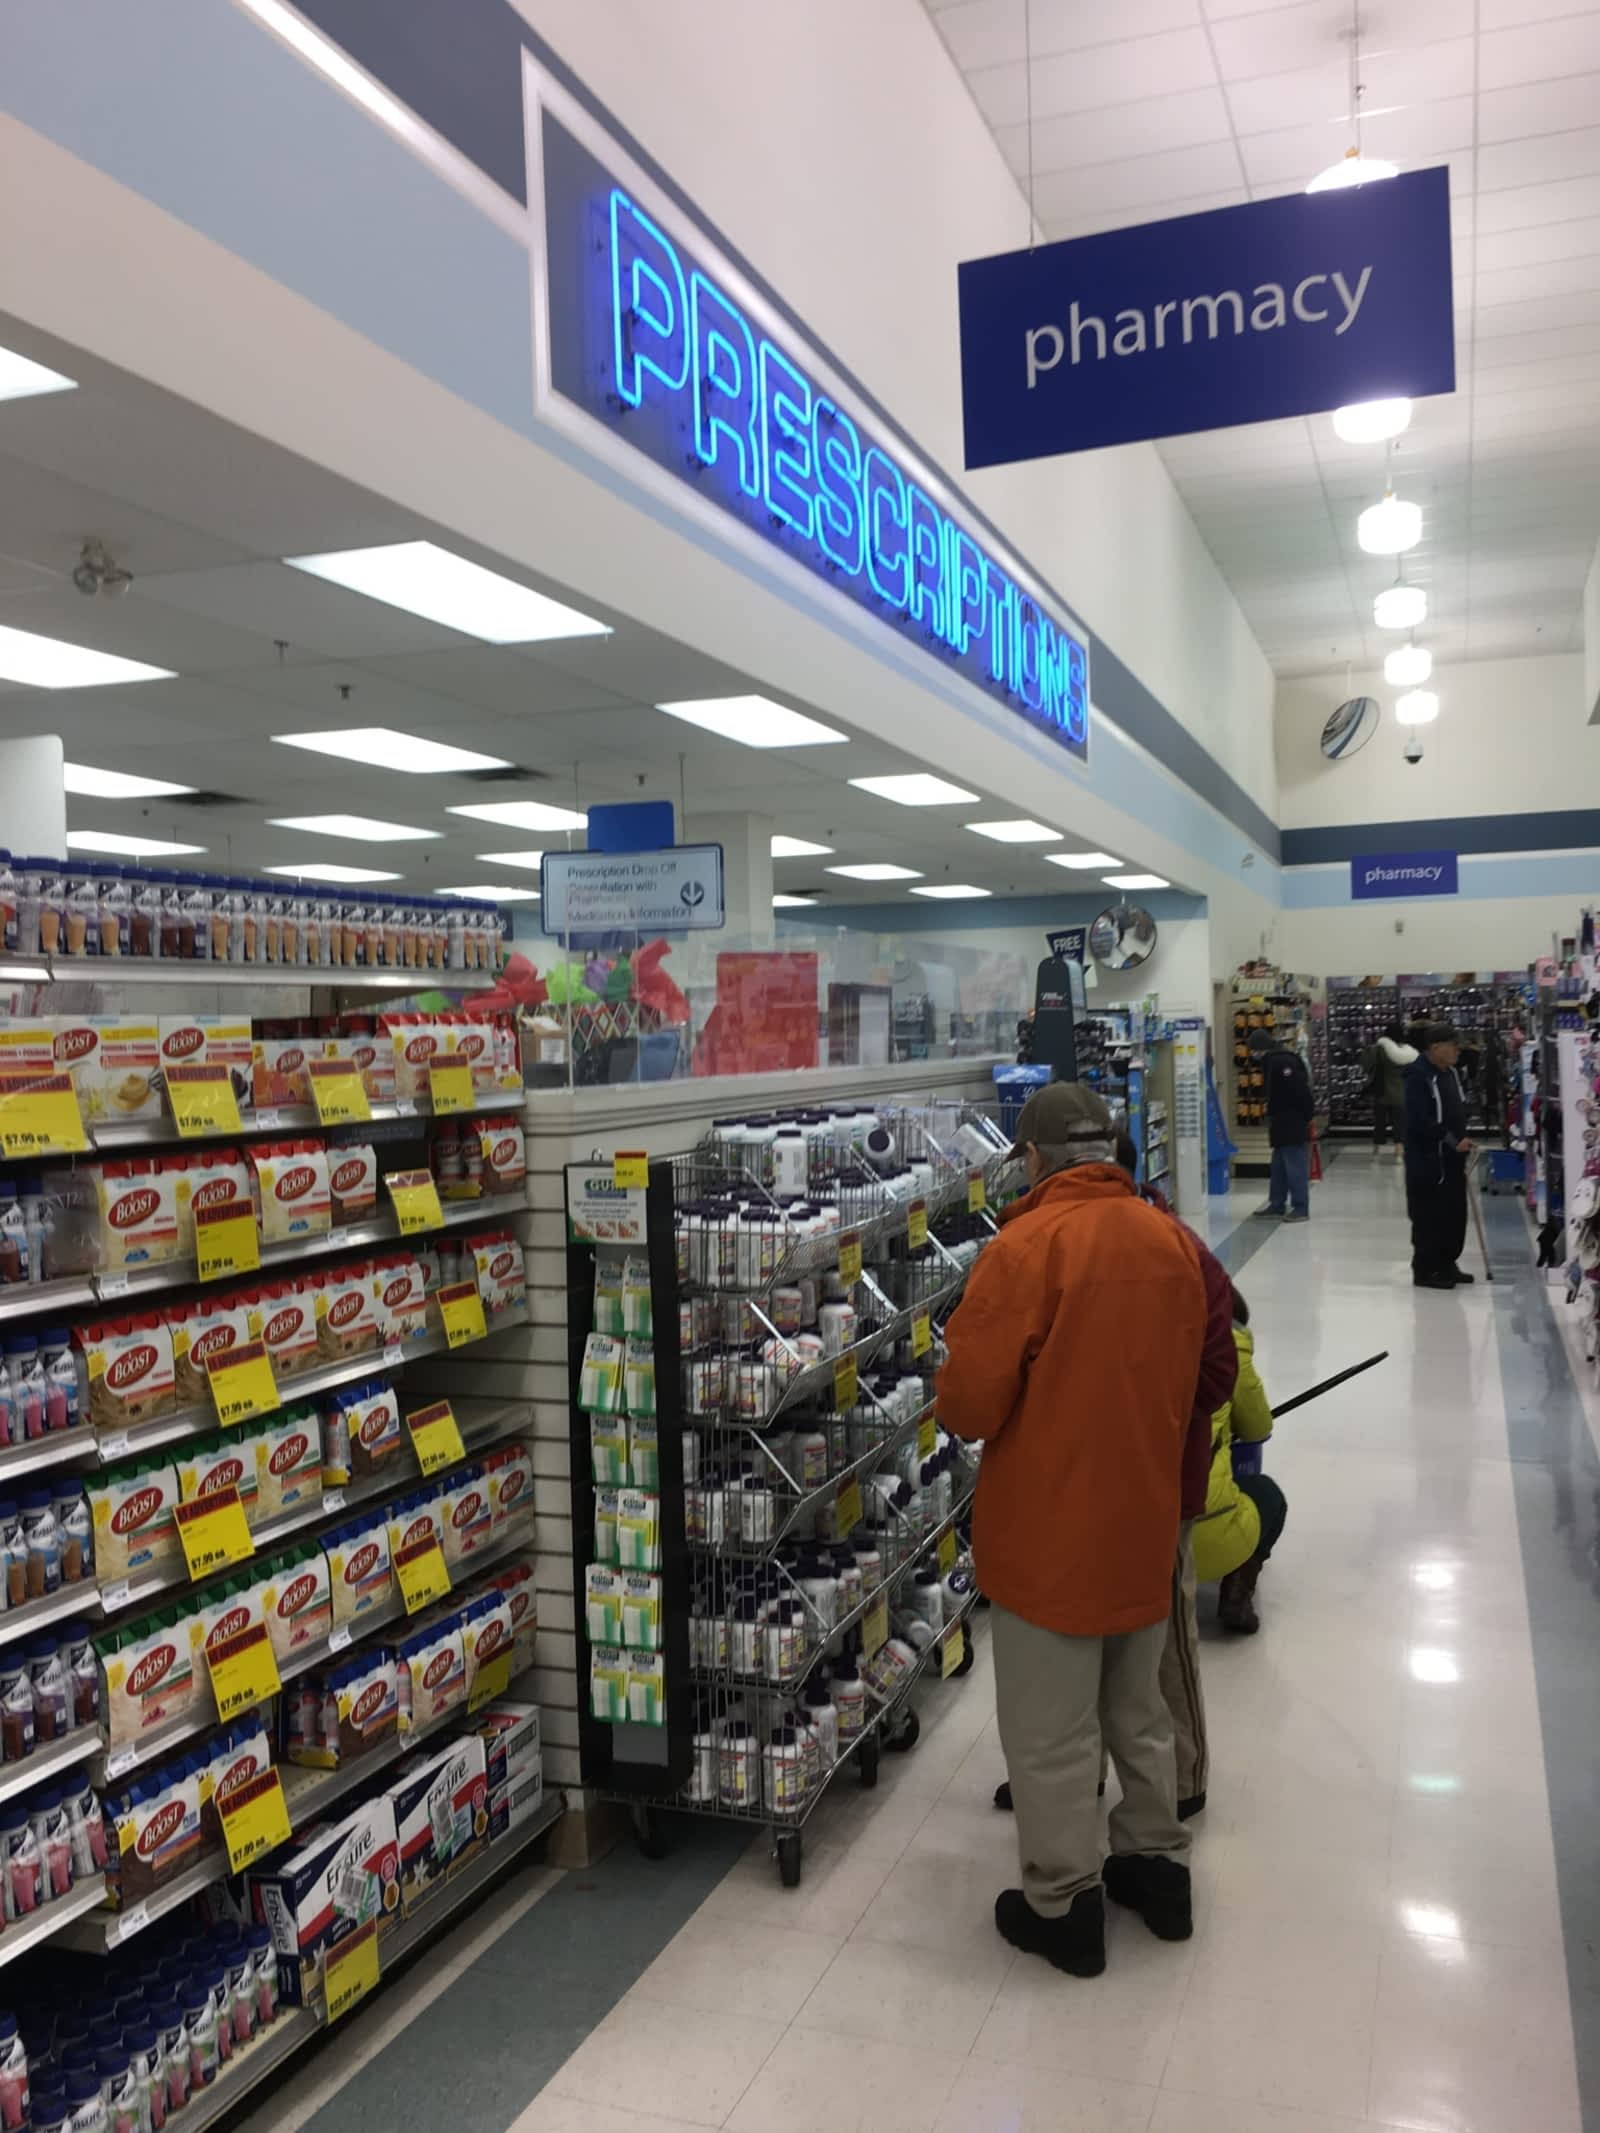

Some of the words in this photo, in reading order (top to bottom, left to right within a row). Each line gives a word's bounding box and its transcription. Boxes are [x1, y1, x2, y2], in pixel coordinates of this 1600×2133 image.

[1024, 266, 1373, 389] pharmacy
[611, 189, 1088, 743] PRESCRIPTIONS
[567, 865, 629, 880] Prescription
[1365, 866, 1443, 885] pharmacy
[1053, 935, 1081, 952] FREE
[169, 1031, 199, 1053] BOOST
[179, 1117, 202, 1127] $7.99
[5, 1133, 35, 1145] $7.99
[37, 1134, 50, 1144] ea
[279, 1169, 312, 1195] BOOST
[335, 1162, 364, 1188] BOOST
[116, 1194, 153, 1223] BOOST
[198, 1182, 231, 1208] BOOST
[201, 1259, 222, 1273] $7.99
[385, 1280, 410, 1304] BOOST
[332, 1294, 360, 1323] BOOST
[268, 1311, 298, 1339] BOOST
[198, 1328, 231, 1358] BOOST
[114, 1350, 151, 1382] BOOST
[220, 1402, 242, 1419] $7.99
[273, 1438, 303, 1471] BOOST
[204, 1463, 237, 1496] BOOST
[119, 1493, 157, 1528] BOOST
[191, 1551, 213, 1570] $7.99
[349, 1546, 378, 1581] BOOST
[282, 1578, 312, 1613] BOOST
[212, 1611, 244, 1647] BOOST
[133, 1648, 169, 1691] BOOST
[221, 1691, 242, 1712] $7.99
[356, 1683, 386, 1720] BOOST
[221, 1760, 251, 1800] BOOST
[146, 1806, 180, 1849] BOOST
[233, 1842, 255, 1863] $7.99
